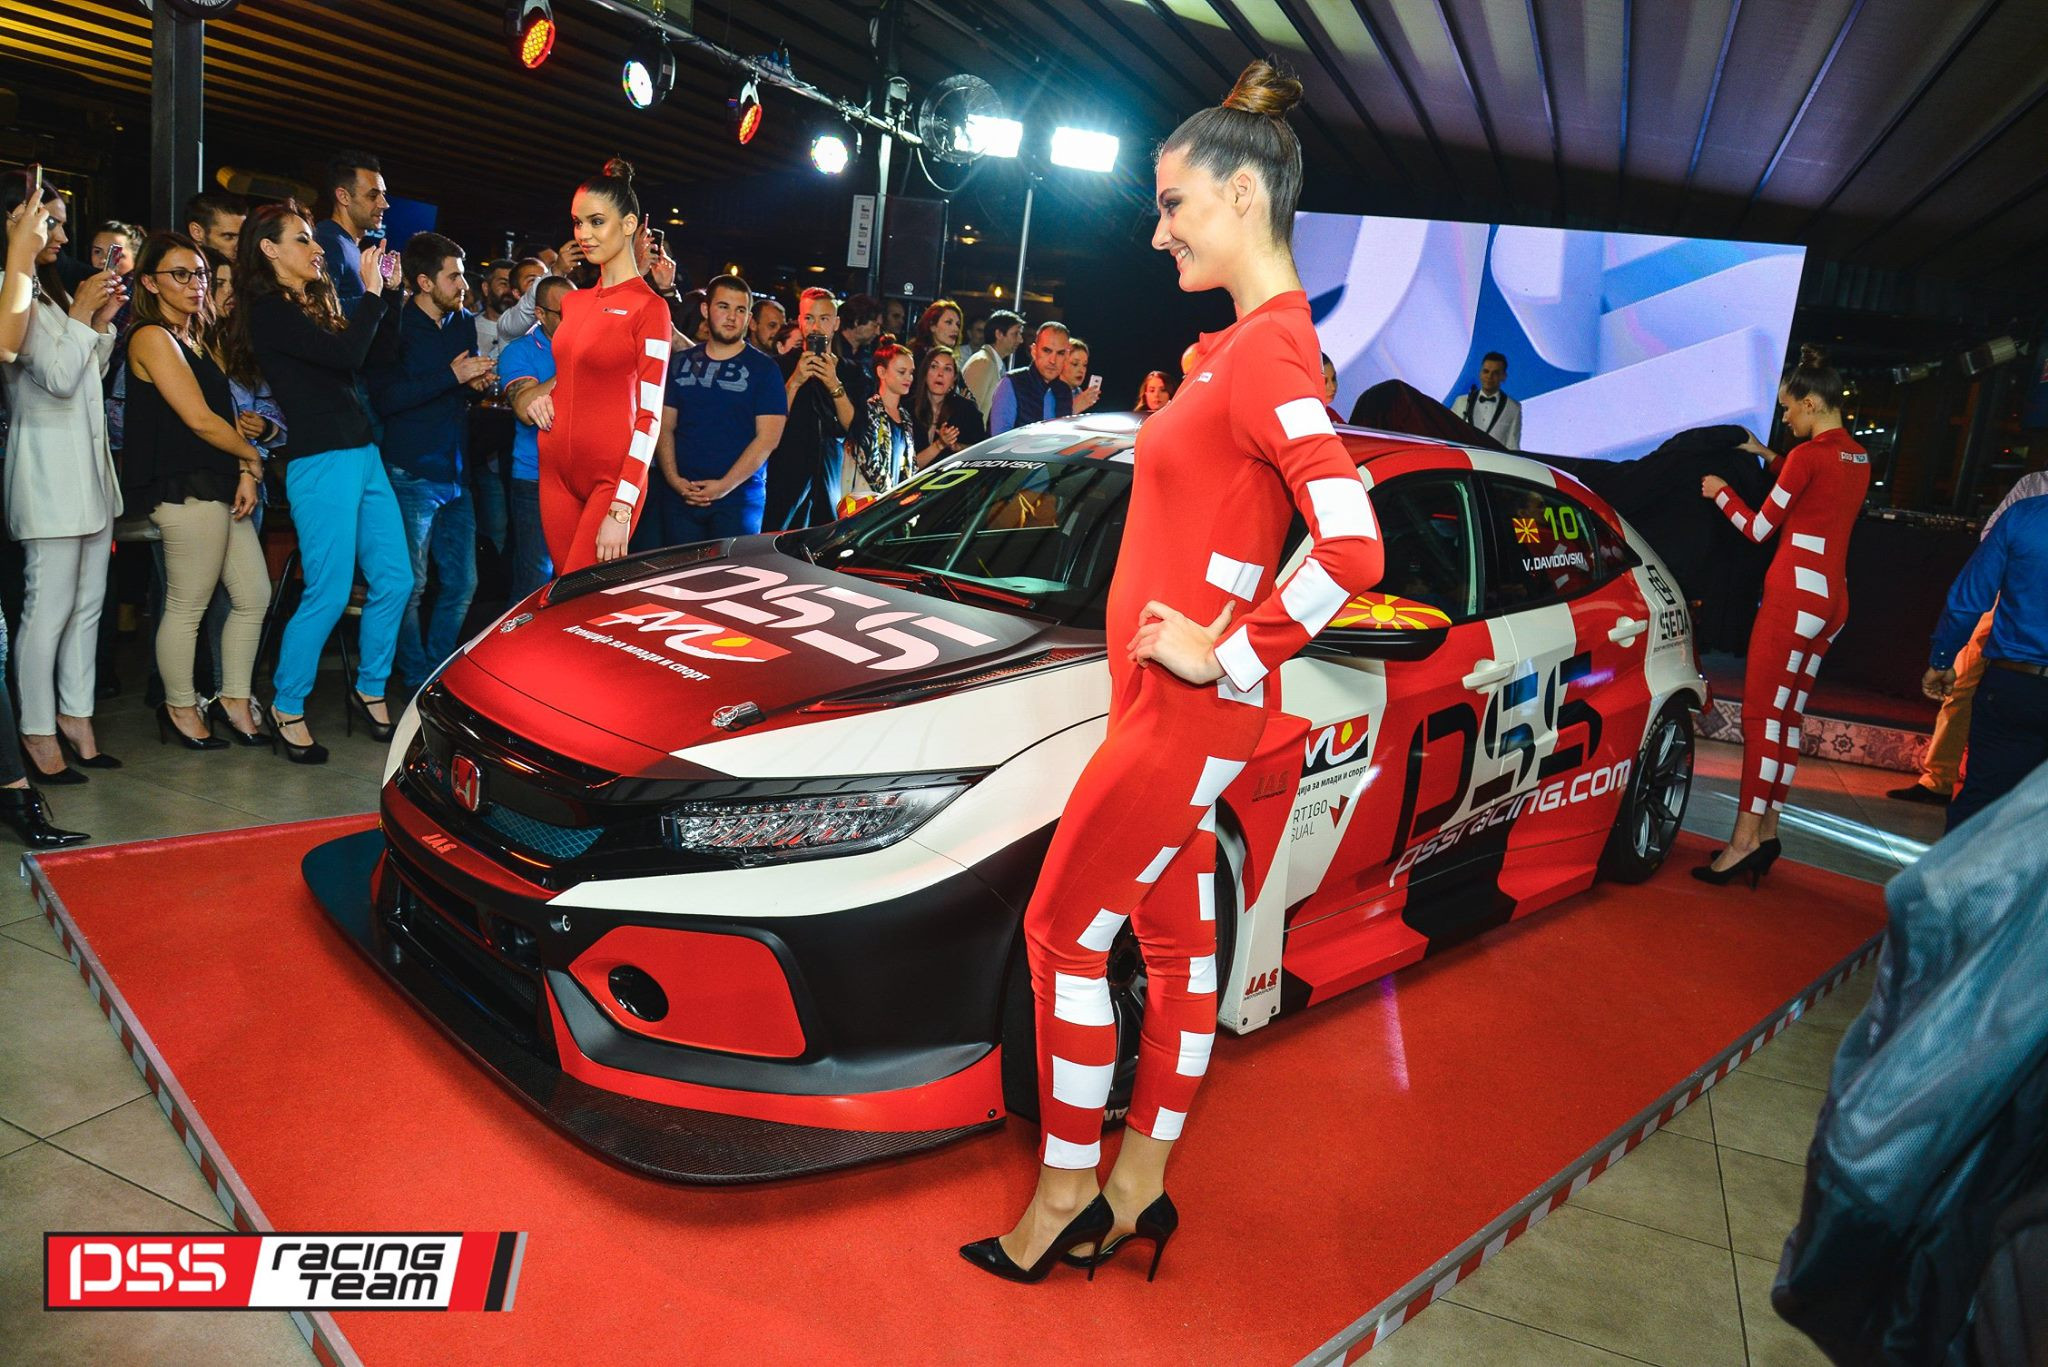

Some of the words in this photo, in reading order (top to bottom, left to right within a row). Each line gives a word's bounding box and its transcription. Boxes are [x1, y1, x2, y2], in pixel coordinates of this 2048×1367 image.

[1544, 506, 1579, 541] 10
[609, 640, 627, 648] за
[621, 645, 665, 661] млади
[668, 664, 711, 681] спорт
[1348, 765, 1367, 778] спорт
